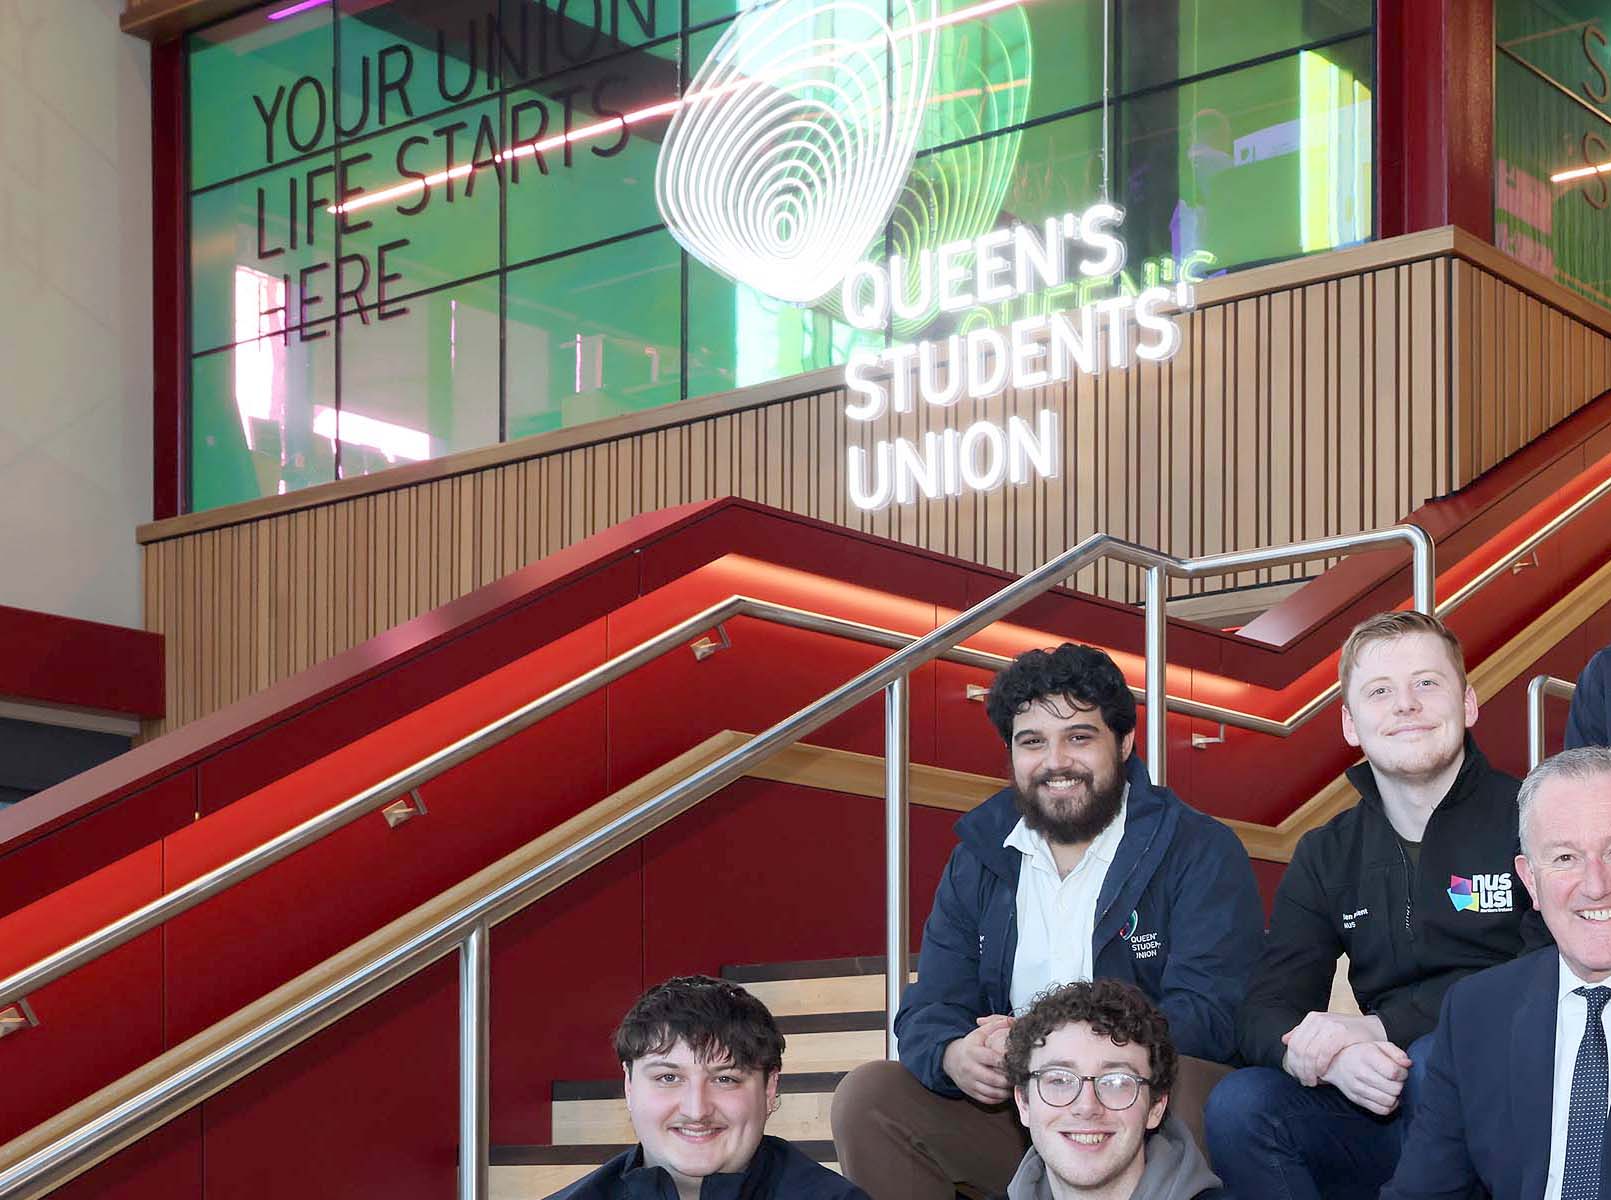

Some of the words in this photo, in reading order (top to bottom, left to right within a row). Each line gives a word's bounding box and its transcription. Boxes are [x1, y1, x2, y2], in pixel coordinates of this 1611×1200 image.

[253, 44, 414, 163] YOUR
[257, 151, 374, 261] LIFE
[396, 74, 631, 217] STARTS
[258, 238, 412, 351] HERE
[842, 203, 1127, 331] QUEEN'S
[844, 282, 1197, 421] STUDENTS'
[847, 408, 1059, 511] UNION
[1472, 872, 1513, 892] nus
